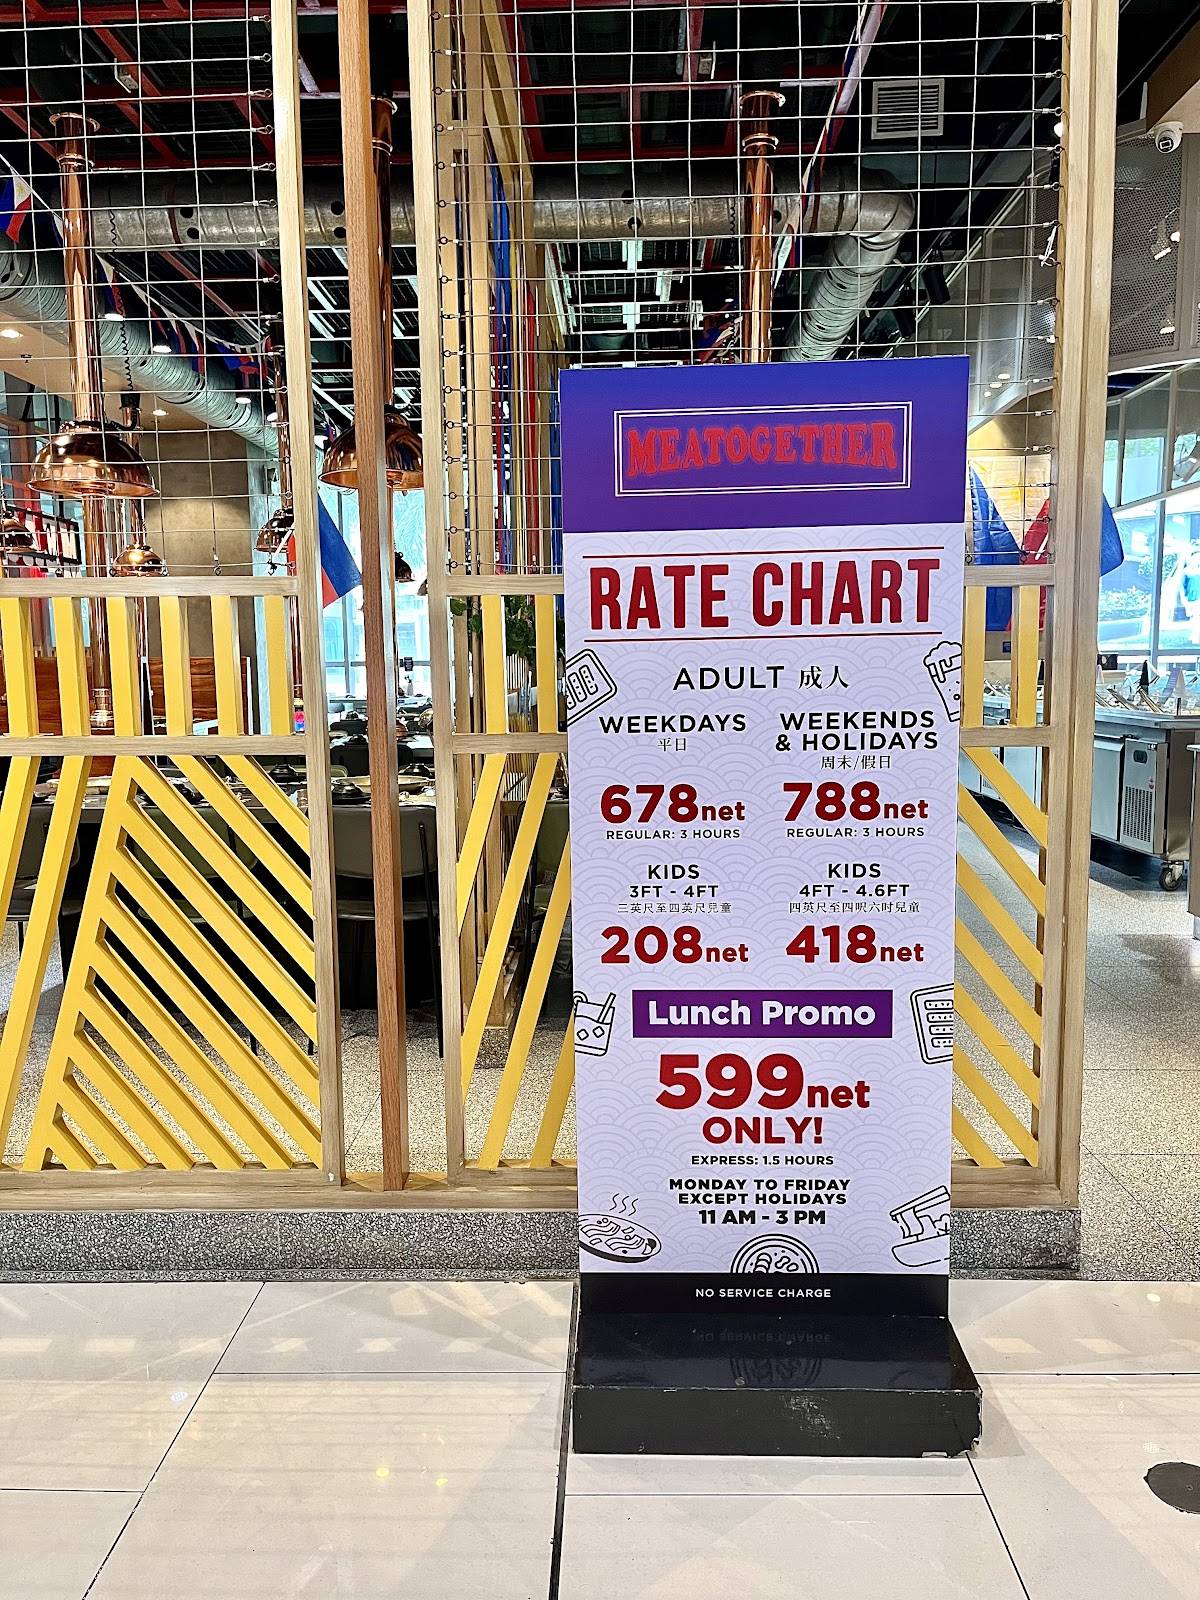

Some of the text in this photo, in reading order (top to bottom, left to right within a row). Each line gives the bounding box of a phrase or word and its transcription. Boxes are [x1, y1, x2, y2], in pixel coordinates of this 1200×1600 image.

[628, 423, 896, 476] MEATOGETHER
[590, 559, 940, 630] RATE CHART
[672, 665, 849, 691] ADULT 成人
[598, 713, 746, 734] WEEKDAYS
[779, 710, 935, 731] WEEKENDS
[657, 737, 687, 752] 平日
[775, 731, 938, 752] & HOLIDAYS
[606, 828, 741, 840] REGULAR: 3 HOURS
[786, 826, 925, 838] REGULAR: 3 HOURS
[648, 863, 700, 880] KIDS
[828, 862, 881, 879] KIDS
[629, 885, 663, 899] 3FT
[683, 884, 719, 898] 4FT
[798, 884, 835, 898] 4FT
[855, 883, 910, 897] 4.6FT
[648, 999, 876, 1026] Lunch Promo
[703, 1116, 822, 1145] ONLY!
[691, 1155, 834, 1166] EXPRESS: 1.5 HOURS
[669, 1178, 851, 1191] MONDAY TO FRIDAY
[678, 1192, 847, 1205] EXCEPT HOLIDAYS
[698, 1209, 716, 1225] 11
[721, 1209, 756, 1225] AM
[775, 1209, 789, 1225] 3
[794, 1209, 826, 1225] PM
[695, 1288, 831, 1298] NO SERVICE CHARGE
